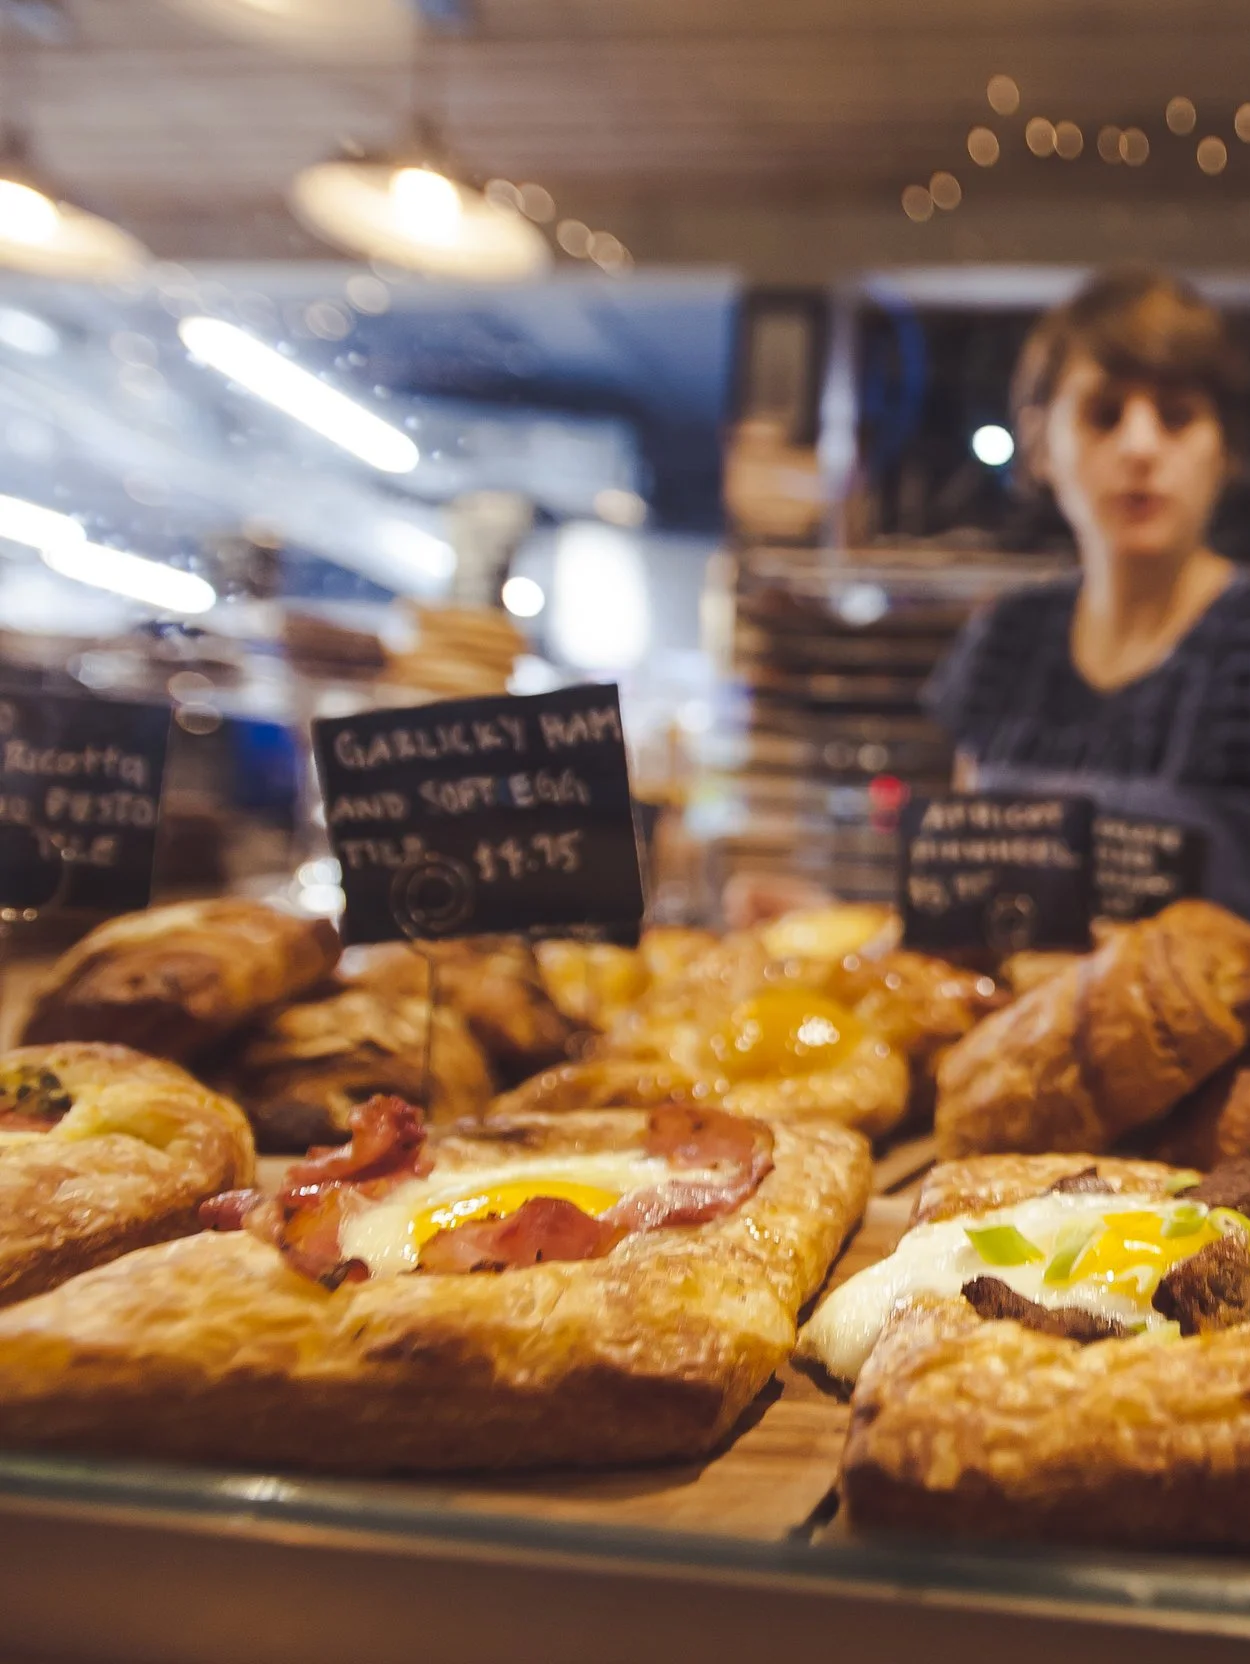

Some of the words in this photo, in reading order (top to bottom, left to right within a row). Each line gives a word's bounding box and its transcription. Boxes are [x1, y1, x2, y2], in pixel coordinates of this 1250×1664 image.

[538, 706, 622, 750] HAM
[331, 791, 408, 822] AND
[418, 777, 495, 815] SOFT
[507, 770, 591, 807] EGG
